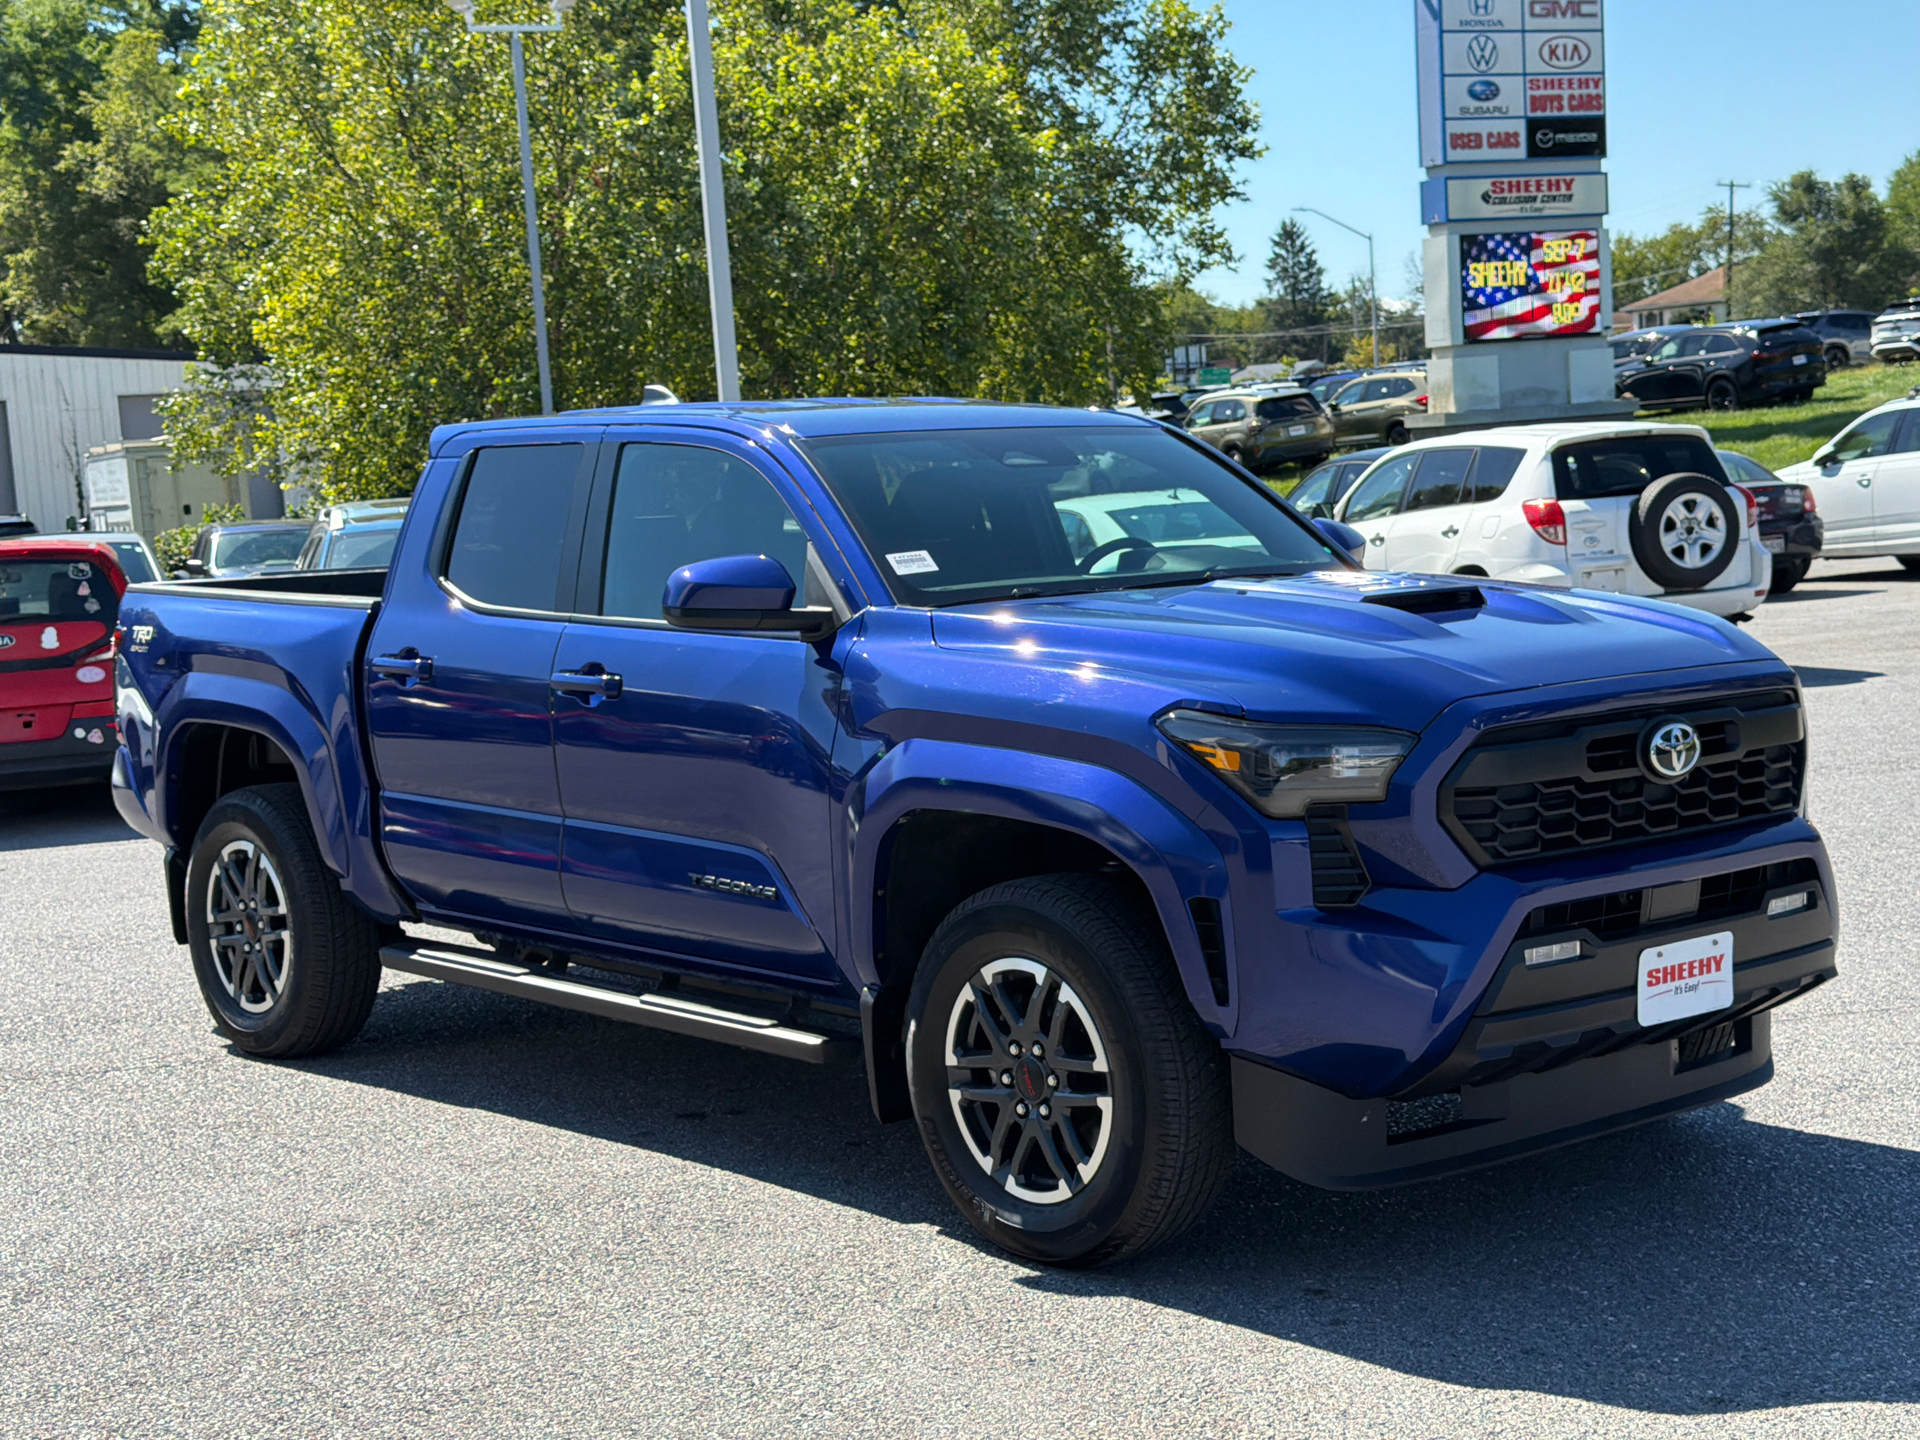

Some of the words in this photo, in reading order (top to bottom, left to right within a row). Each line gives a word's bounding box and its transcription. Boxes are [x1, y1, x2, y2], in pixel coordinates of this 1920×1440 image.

[1530, 0, 1598, 18] GMC
[1459, 20, 1504, 28] HONDA
[1548, 44, 1583, 61] KIA
[1528, 77, 1602, 91] SHEEHY
[1459, 106, 1509, 115] SUBARU
[1530, 94, 1564, 114] BUYS
[1568, 93, 1603, 112] CARS
[1450, 132, 1483, 150] USED
[1487, 131, 1520, 149] CARS
[1490, 178, 1575, 195] SHEEHY
[1543, 240, 1572, 263] SEP
[1469, 261, 1528, 288] SHEEHY
[132, 625, 153, 644] TRD
[687, 872, 777, 900] TACOMA
[1647, 953, 1725, 988] SHEEHY
[1674, 984, 1683, 996] It's
[1684, 979, 1700, 994] Easy!
